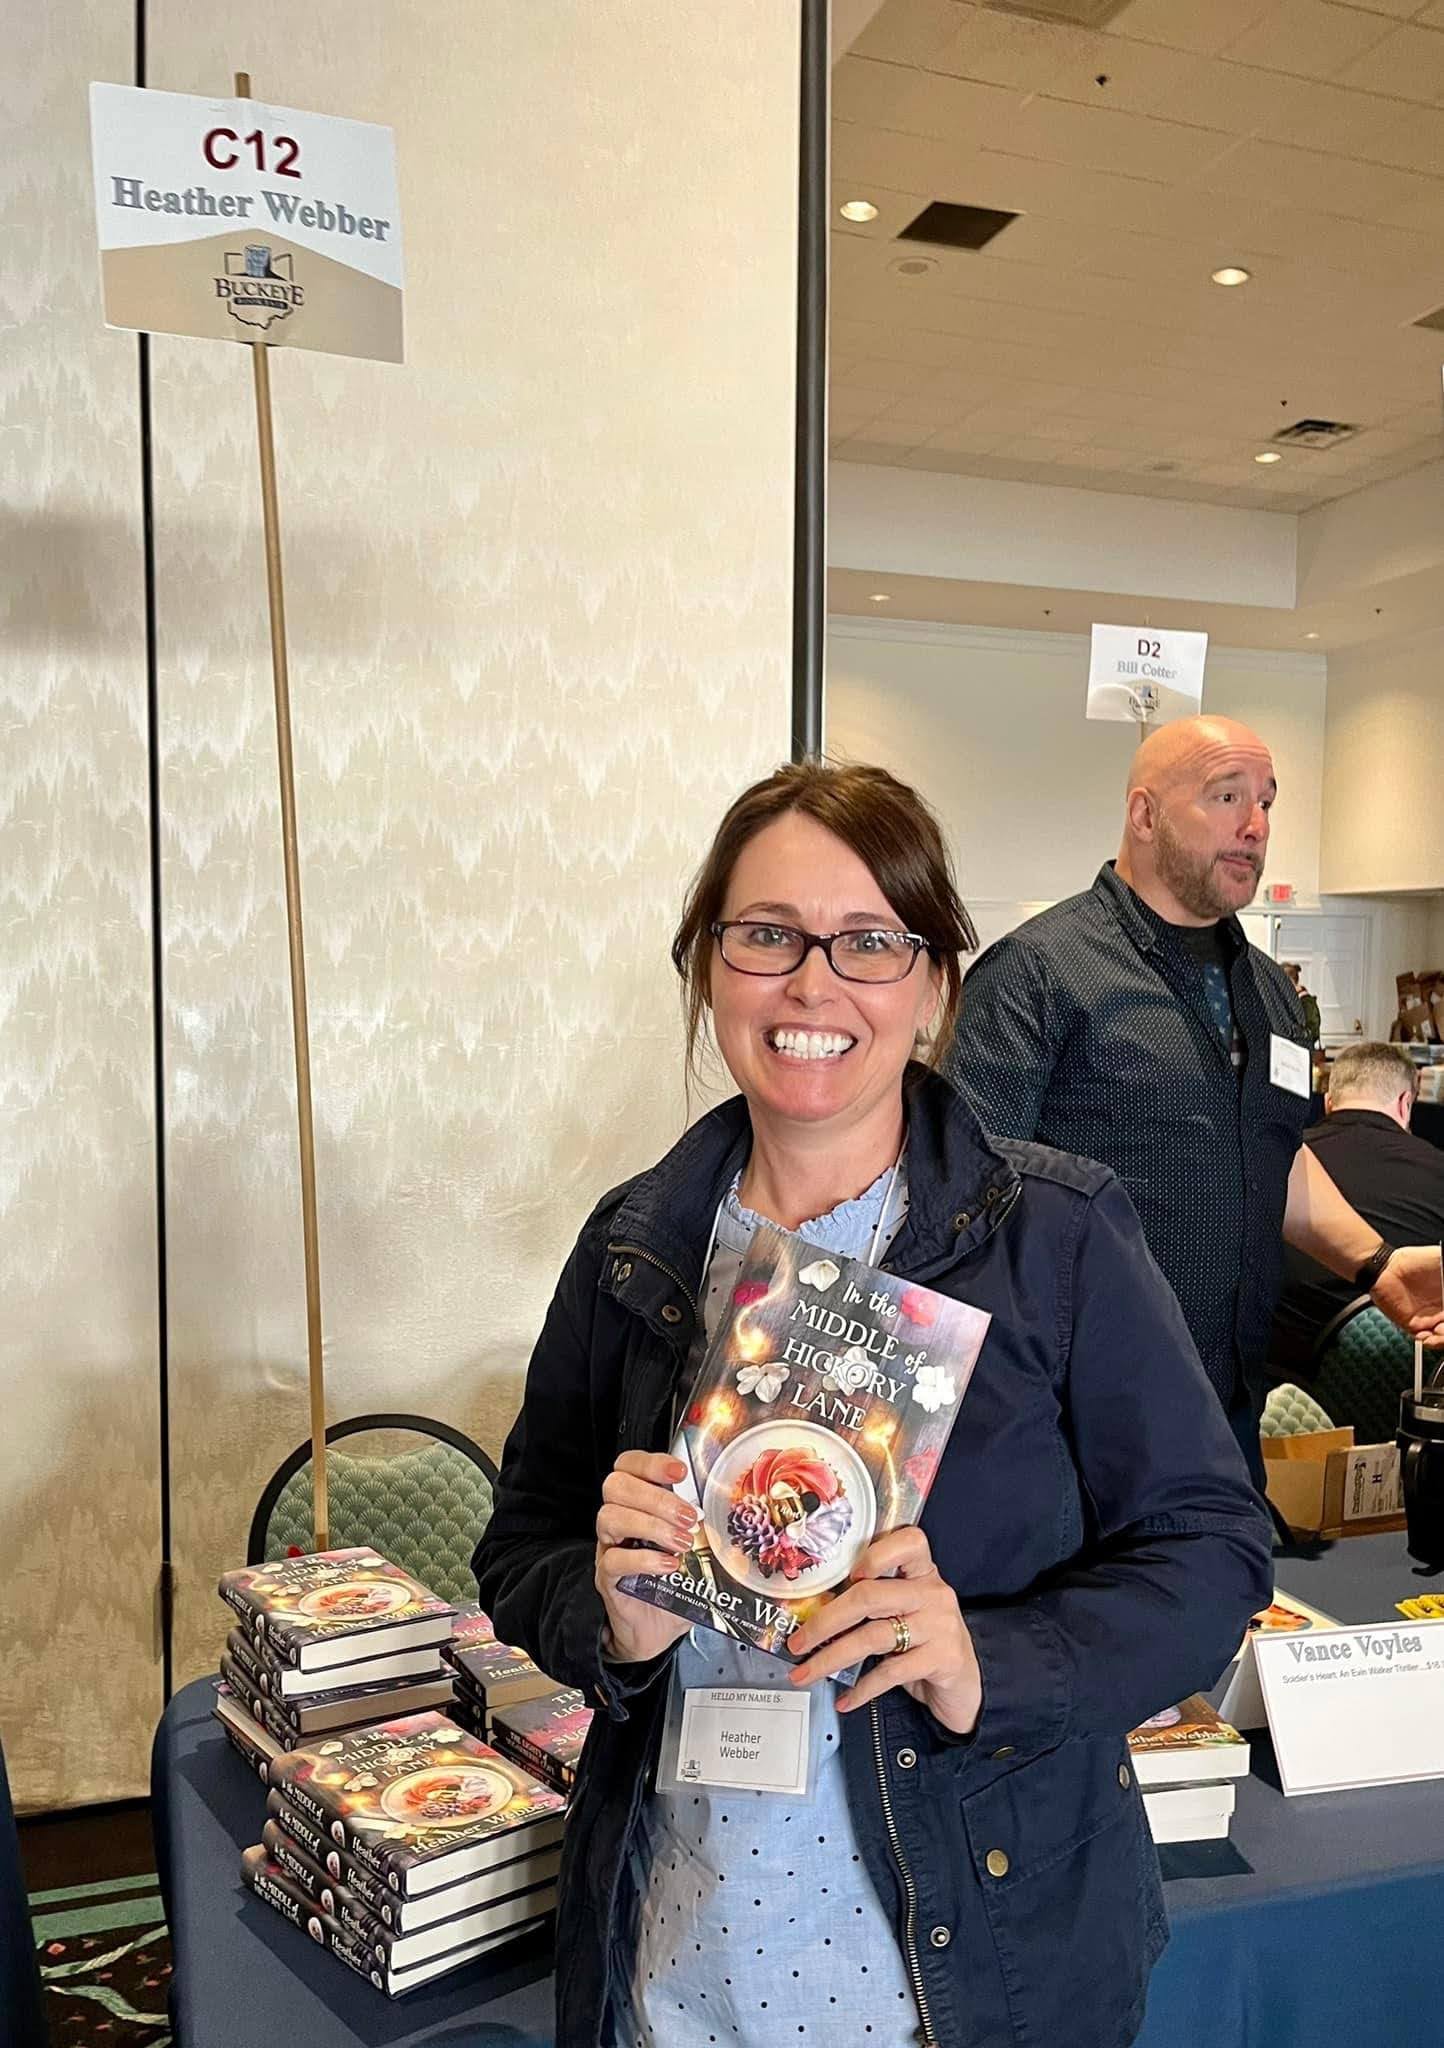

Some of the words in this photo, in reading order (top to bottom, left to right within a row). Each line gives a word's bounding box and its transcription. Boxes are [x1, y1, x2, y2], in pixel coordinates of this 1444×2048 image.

[203, 127, 302, 178] C12
[111, 176, 254, 218] Heather
[261, 190, 390, 242] Webber
[213, 278, 304, 306] BUCKEYE
[1137, 639, 1160, 658] D2
[1117, 660, 1138, 674] Bill
[842, 1281, 863, 1303] In
[869, 1291, 898, 1317] the
[789, 1299, 899, 1360] MIDDLE
[904, 1351, 927, 1375] of
[782, 1337, 907, 1403] HICKORY
[790, 1383, 867, 1431] LANE
[1286, 1641, 1352, 1663] Vance
[1353, 1633, 1423, 1661] Voyles
[711, 1692, 736, 1701] HELLO
[736, 1693, 747, 1702] MY
[747, 1693, 771, 1703] NAME
[336, 1736, 414, 1765] MIDDLE
[720, 1730, 762, 1744] Heather
[382, 1756, 438, 1779] LANE
[719, 1746, 760, 1760] Webber
[410, 1824, 482, 1855] Heather
